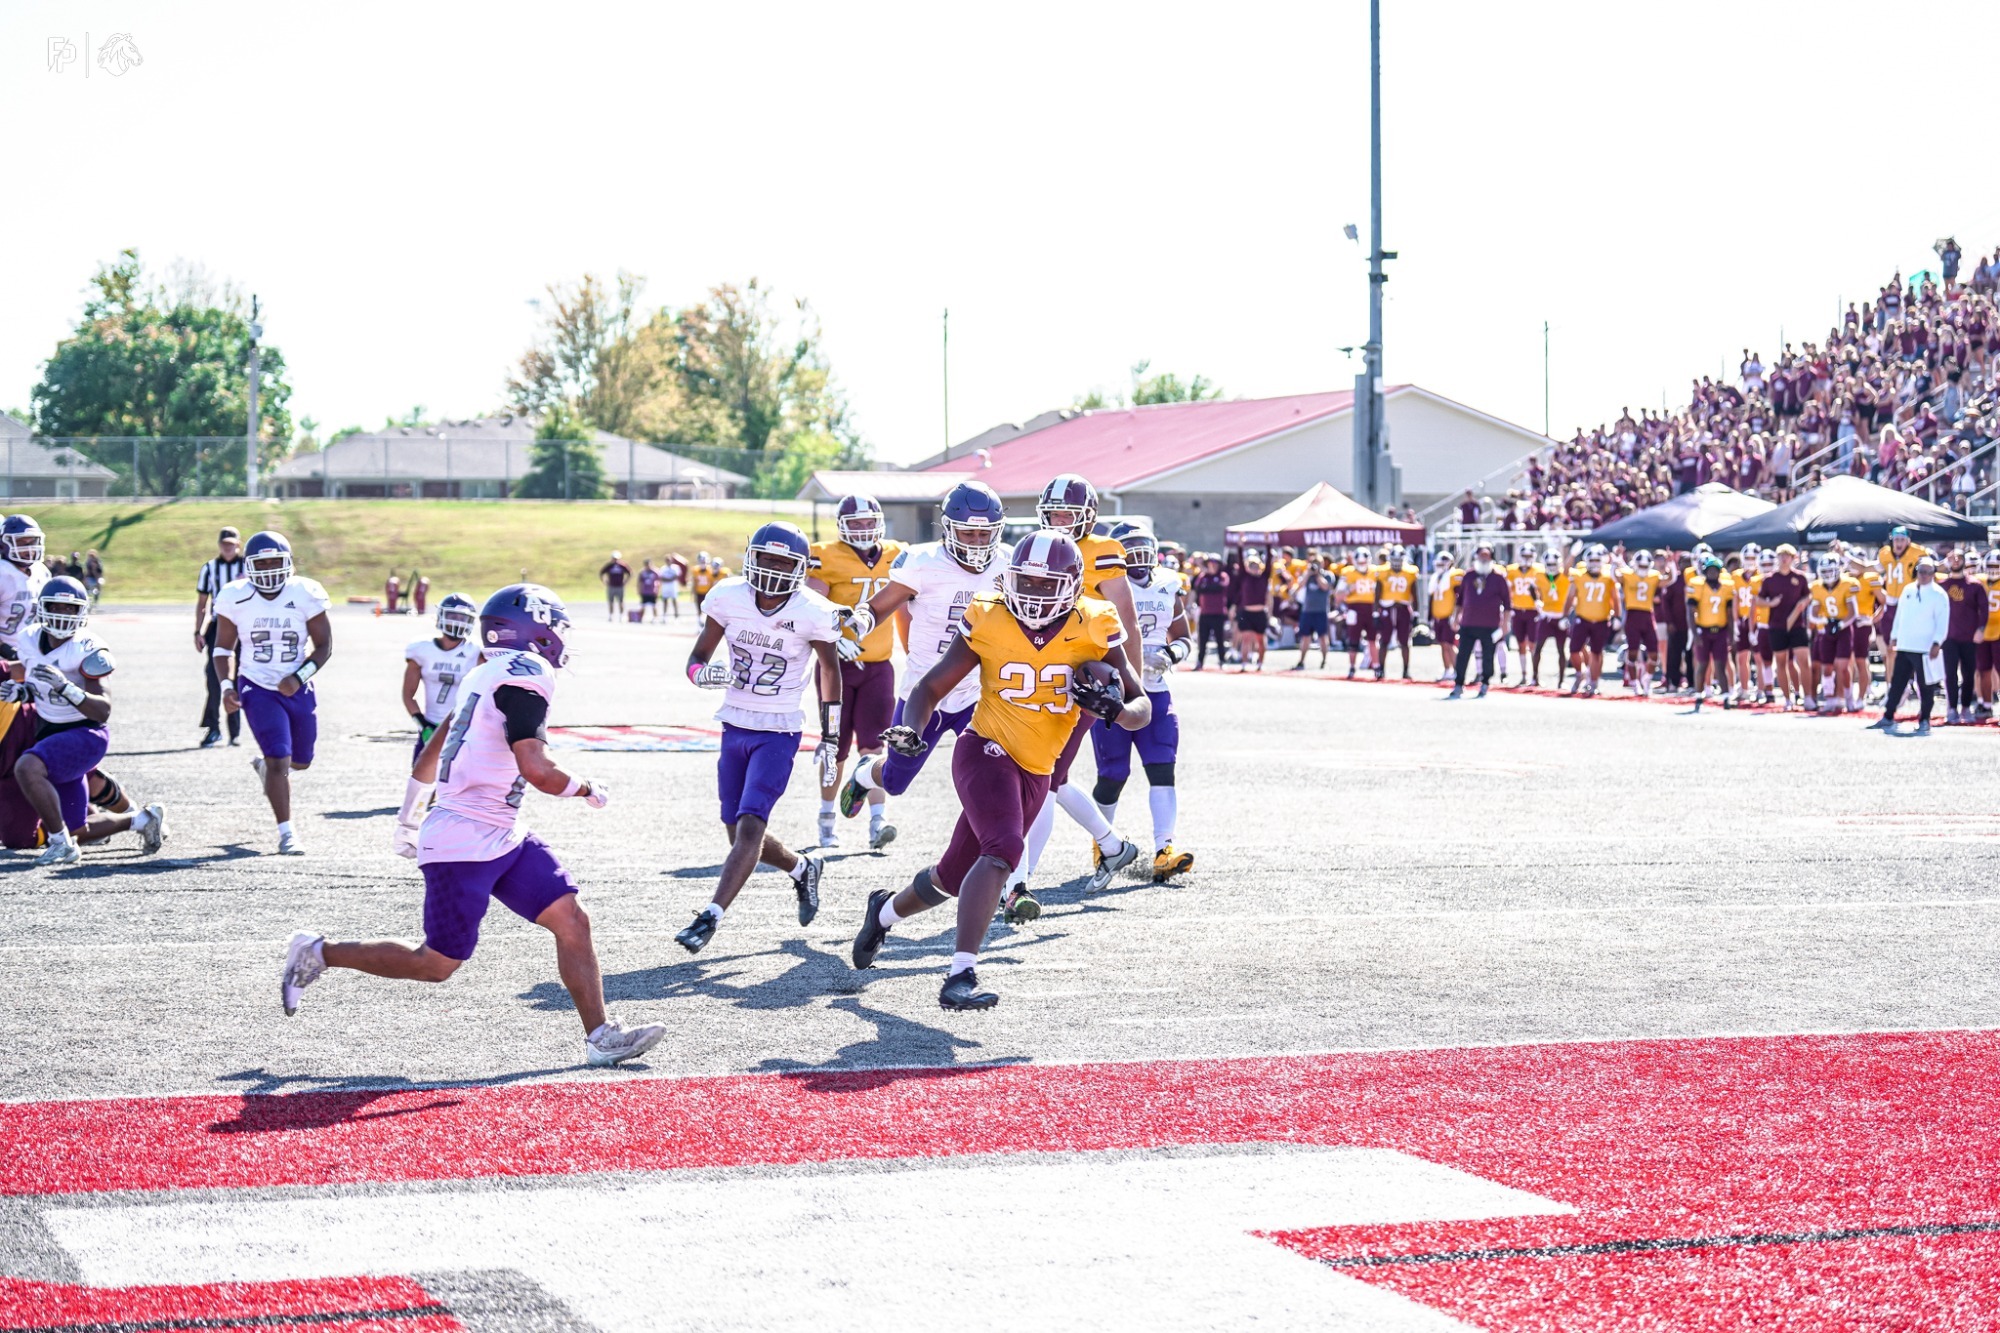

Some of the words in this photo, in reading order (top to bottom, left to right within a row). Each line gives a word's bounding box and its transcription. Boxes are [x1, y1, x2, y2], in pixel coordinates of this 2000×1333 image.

[1303, 530, 1344, 545] VALOR
[1345, 530, 1402, 544] FOOTBALL
[1887, 563, 1904, 584] 14
[1388, 576, 1408, 593] 79
[1584, 582, 1606, 602] 77
[1636, 582, 1649, 601] 2
[1709, 596, 1721, 614] 7
[1825, 596, 1838, 616] 6
[253, 617, 291, 628] AVILA
[250, 630, 299, 663] 53
[736, 630, 784, 651] AVILA
[432, 661, 461, 672] AVILA
[732, 644, 787, 696] 32
[436, 673, 455, 704] 7
[998, 662, 1075, 714] 23
